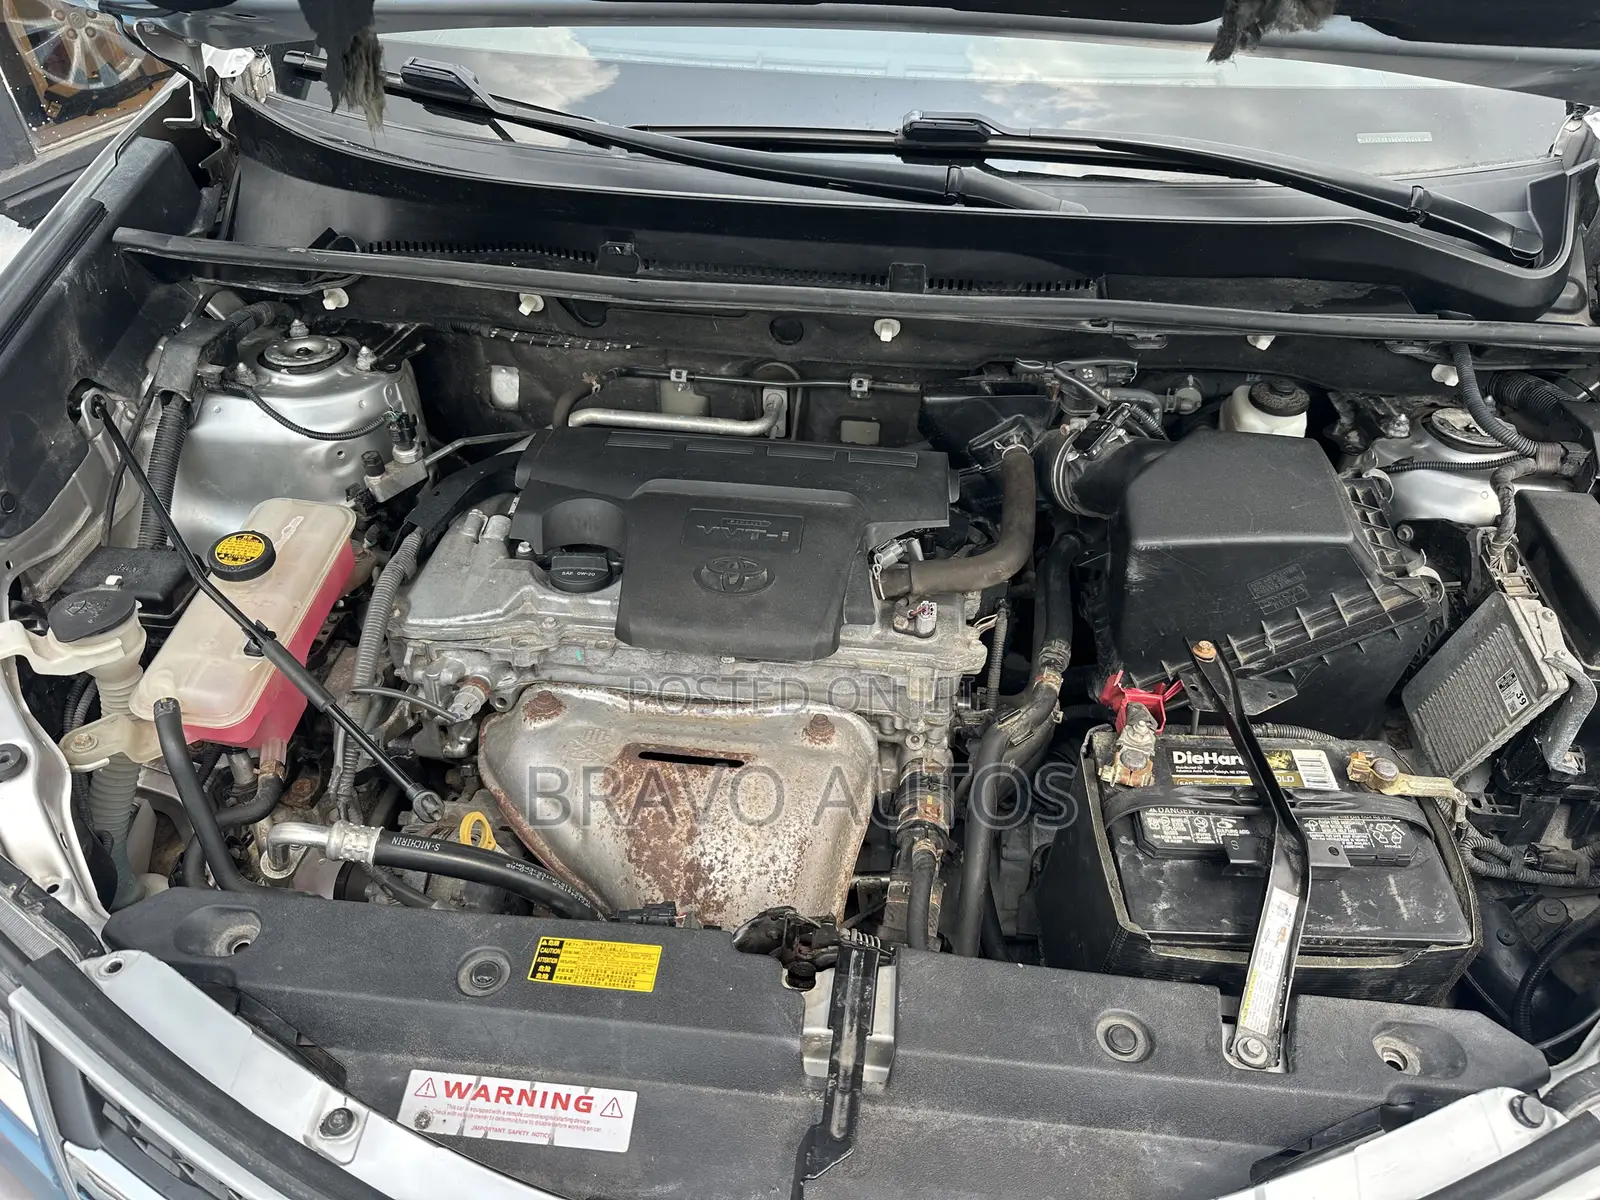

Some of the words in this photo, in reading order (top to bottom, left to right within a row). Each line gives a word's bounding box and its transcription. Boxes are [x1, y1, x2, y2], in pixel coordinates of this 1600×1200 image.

[1515, 690, 1527, 706] 39
[1172, 751, 1245, 766] DieHar
[1275, 775, 1295, 783] OLD
[444, 1080, 594, 1113] WARNING
[507, 1128, 529, 1136] SAFETY
[567, 1123, 586, 1131] working
